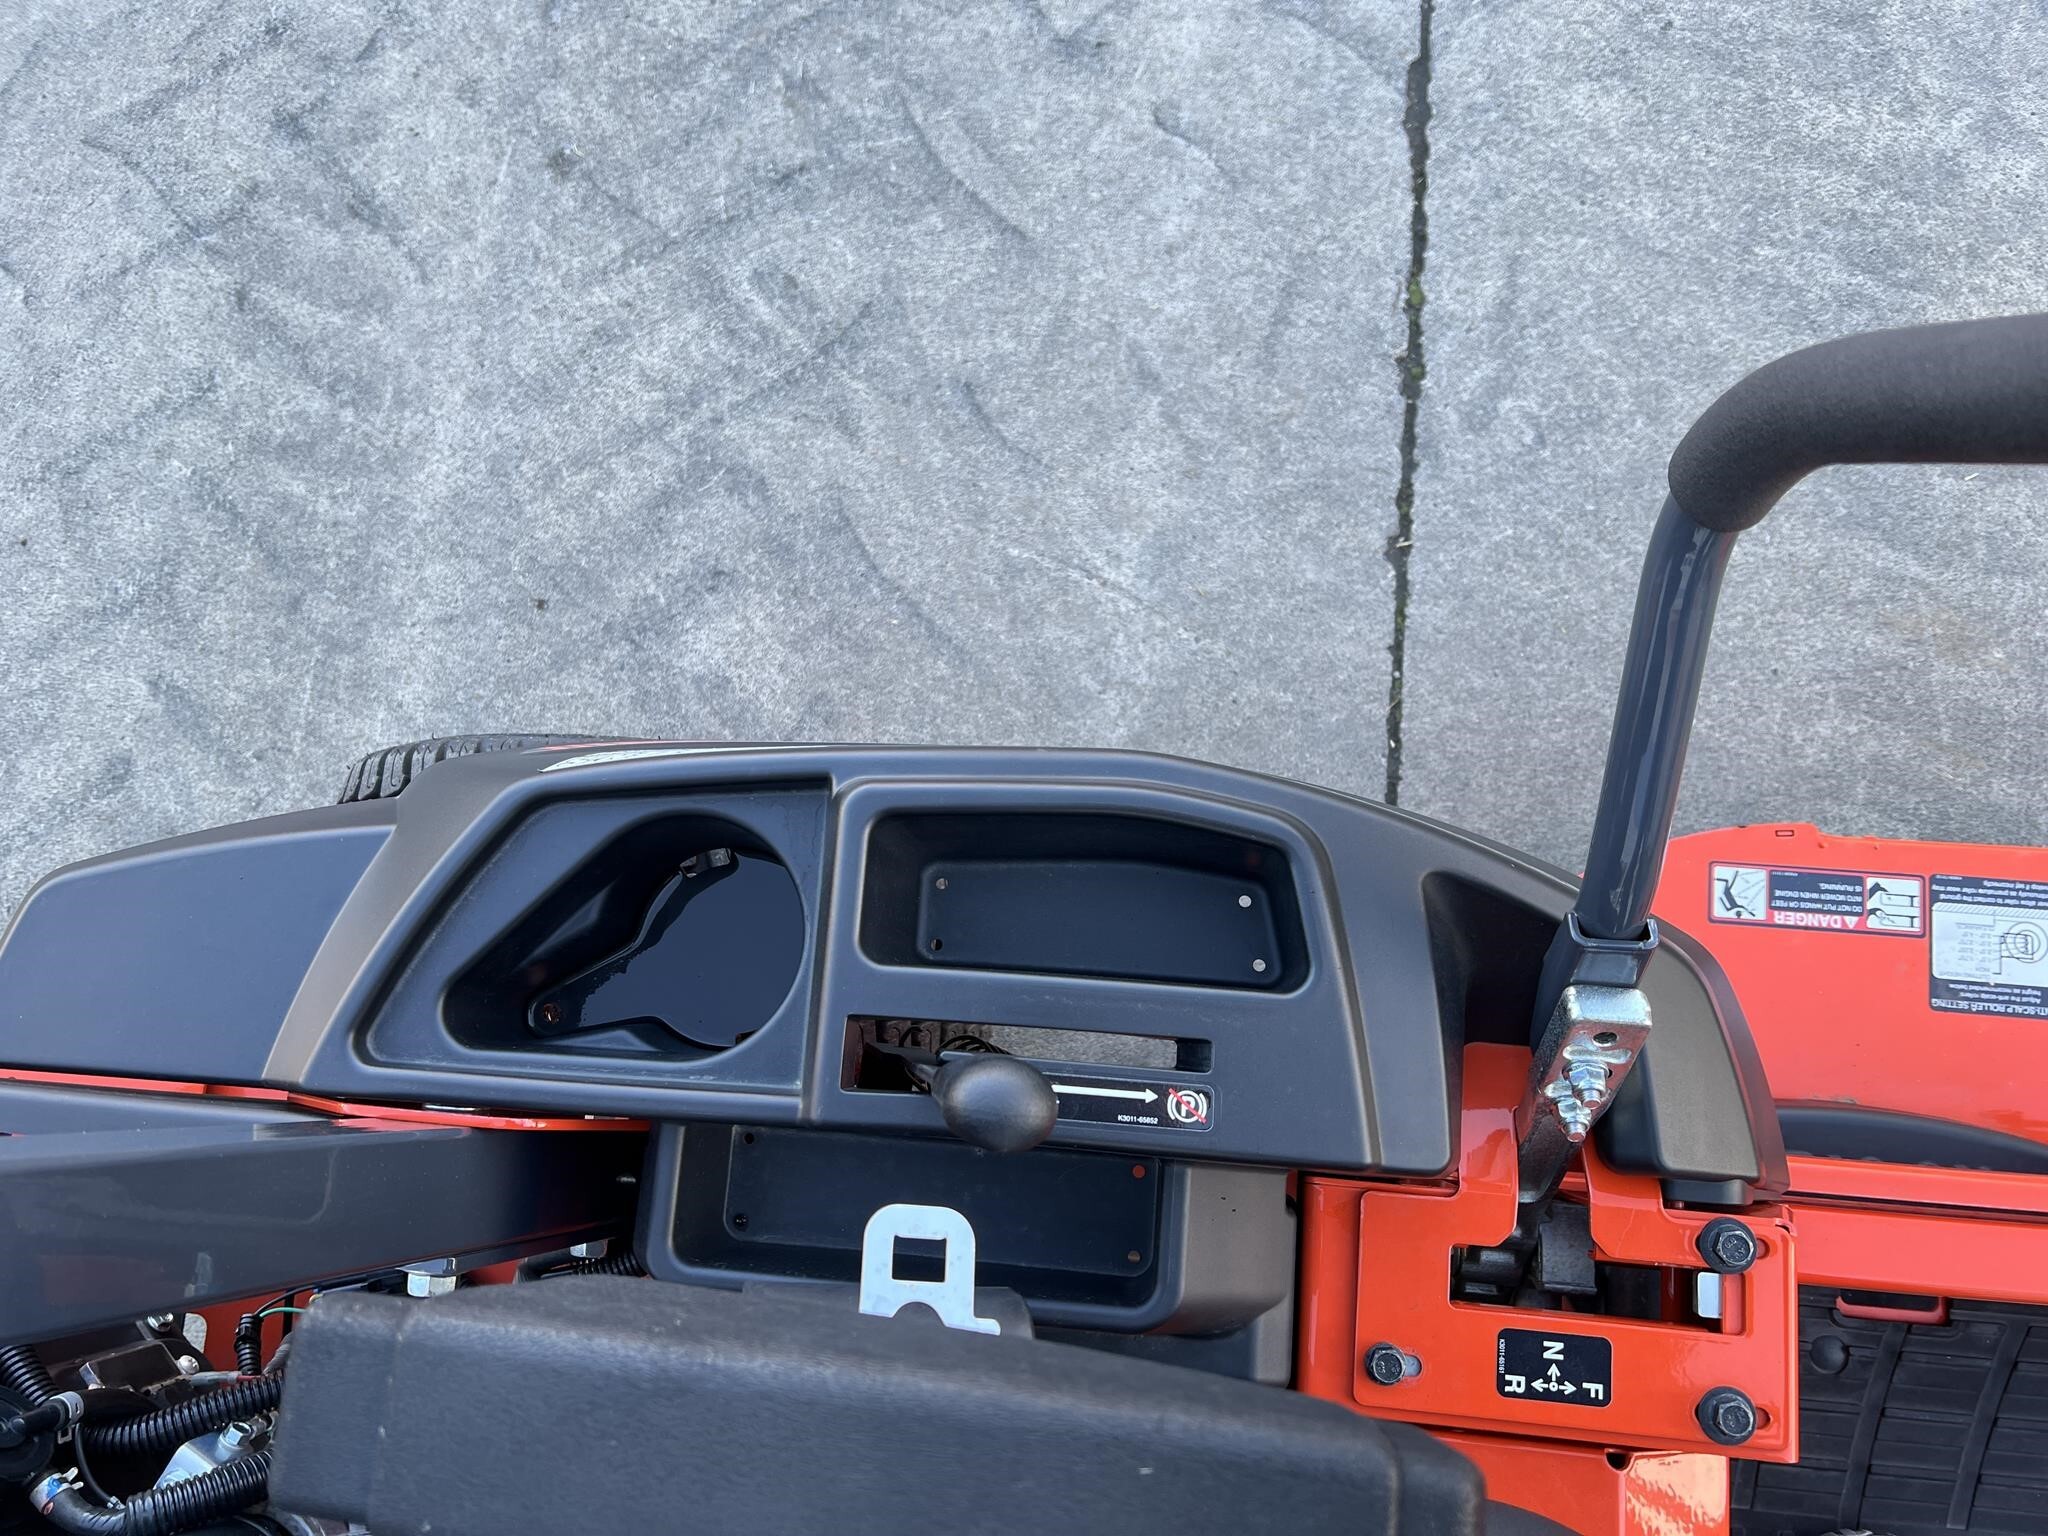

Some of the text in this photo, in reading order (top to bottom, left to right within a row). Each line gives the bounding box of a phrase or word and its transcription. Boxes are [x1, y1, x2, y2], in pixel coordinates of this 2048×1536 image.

[1774, 889, 1799, 899] ENGINE
[1800, 891, 1820, 900] WHEN
[1820, 893, 1846, 902] MOWER
[1771, 900, 1862, 913] DO NOT PUT HANDS OR FEET
[1773, 911, 1842, 928] DANGER
[1932, 998, 1969, 1009] SETTING
[1543, 1340, 1564, 1360] N
[1504, 1374, 1525, 1394] R
[1582, 1382, 1604, 1400] F
